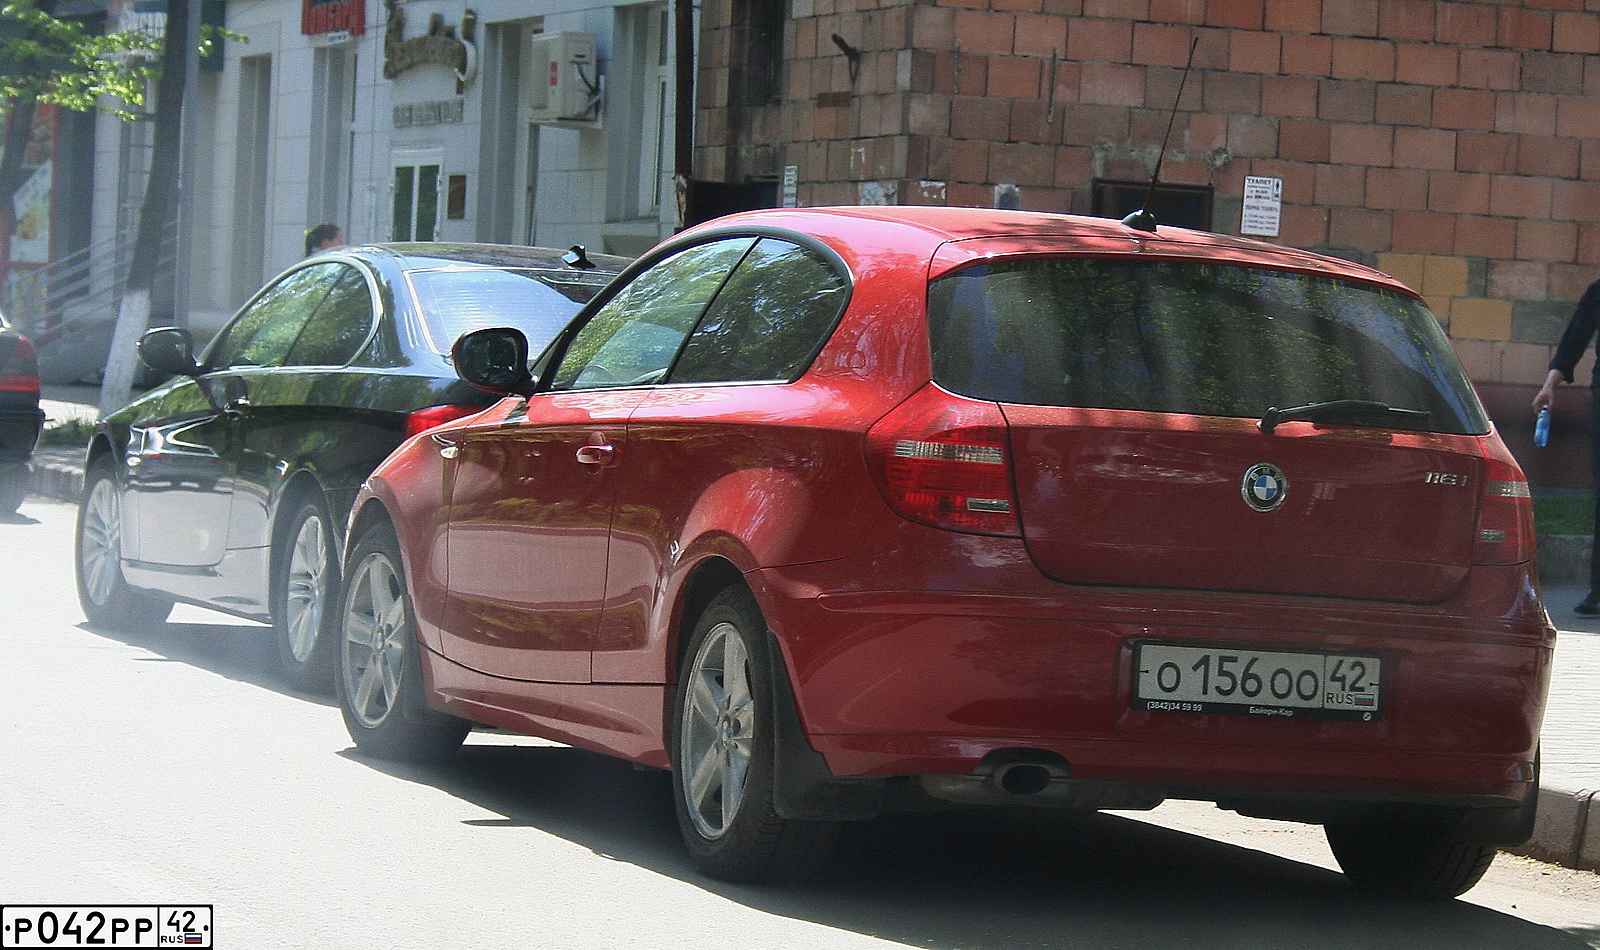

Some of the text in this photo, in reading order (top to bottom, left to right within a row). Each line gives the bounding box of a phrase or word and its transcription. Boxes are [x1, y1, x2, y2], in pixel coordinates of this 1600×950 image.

[1425, 471, 1468, 487] 116i
[1330, 659, 1367, 692] 42
[1326, 692, 1354, 705] RUS
